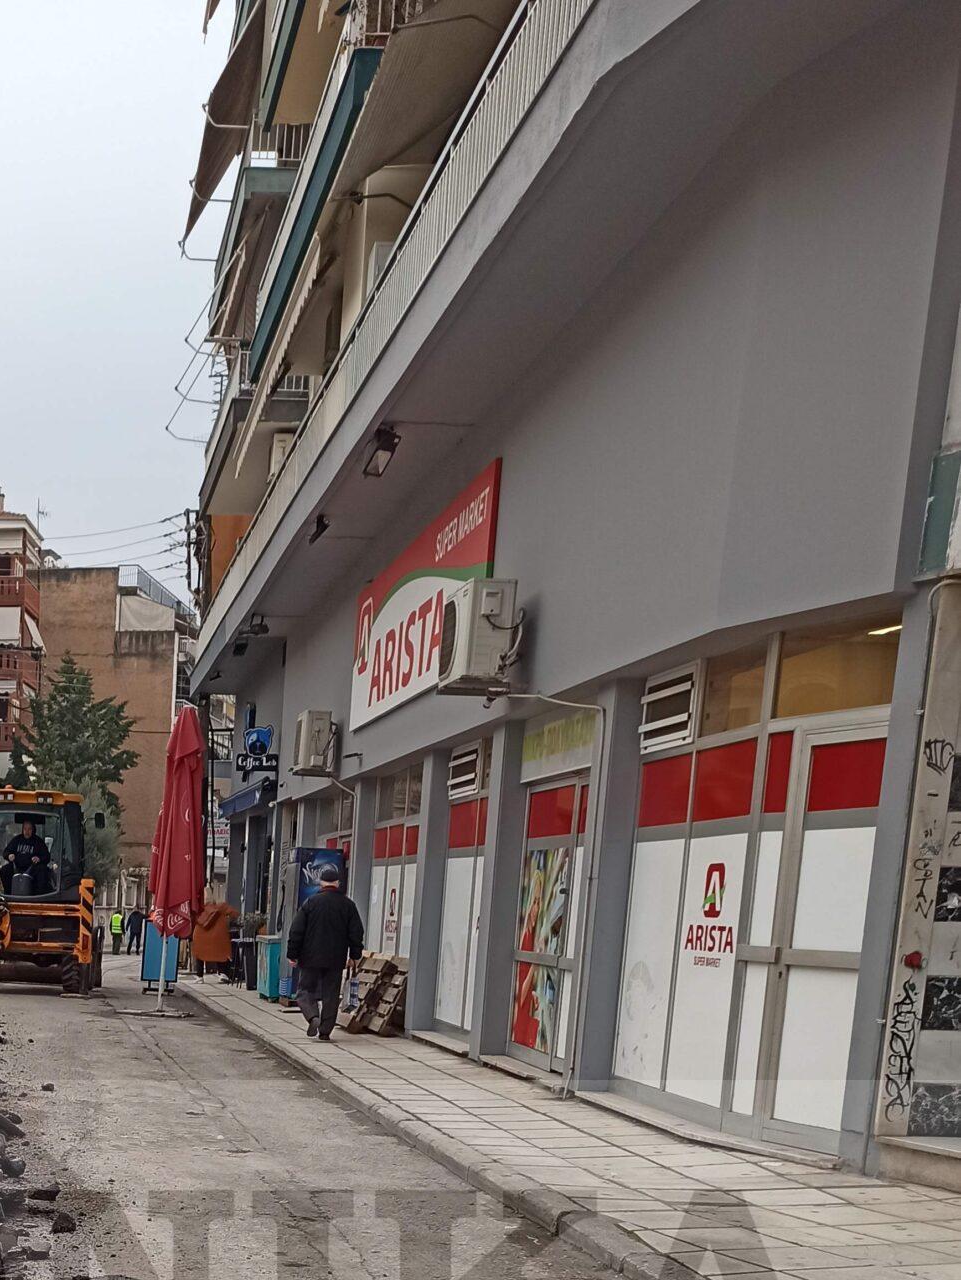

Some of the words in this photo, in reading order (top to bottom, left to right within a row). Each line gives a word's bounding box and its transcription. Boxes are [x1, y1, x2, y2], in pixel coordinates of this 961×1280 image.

[435, 516, 458, 562] SUPER
[458, 486, 490, 542] MARKET
[367, 588, 444, 708] ARISTA
[684, 924, 734, 953] ARISTA
